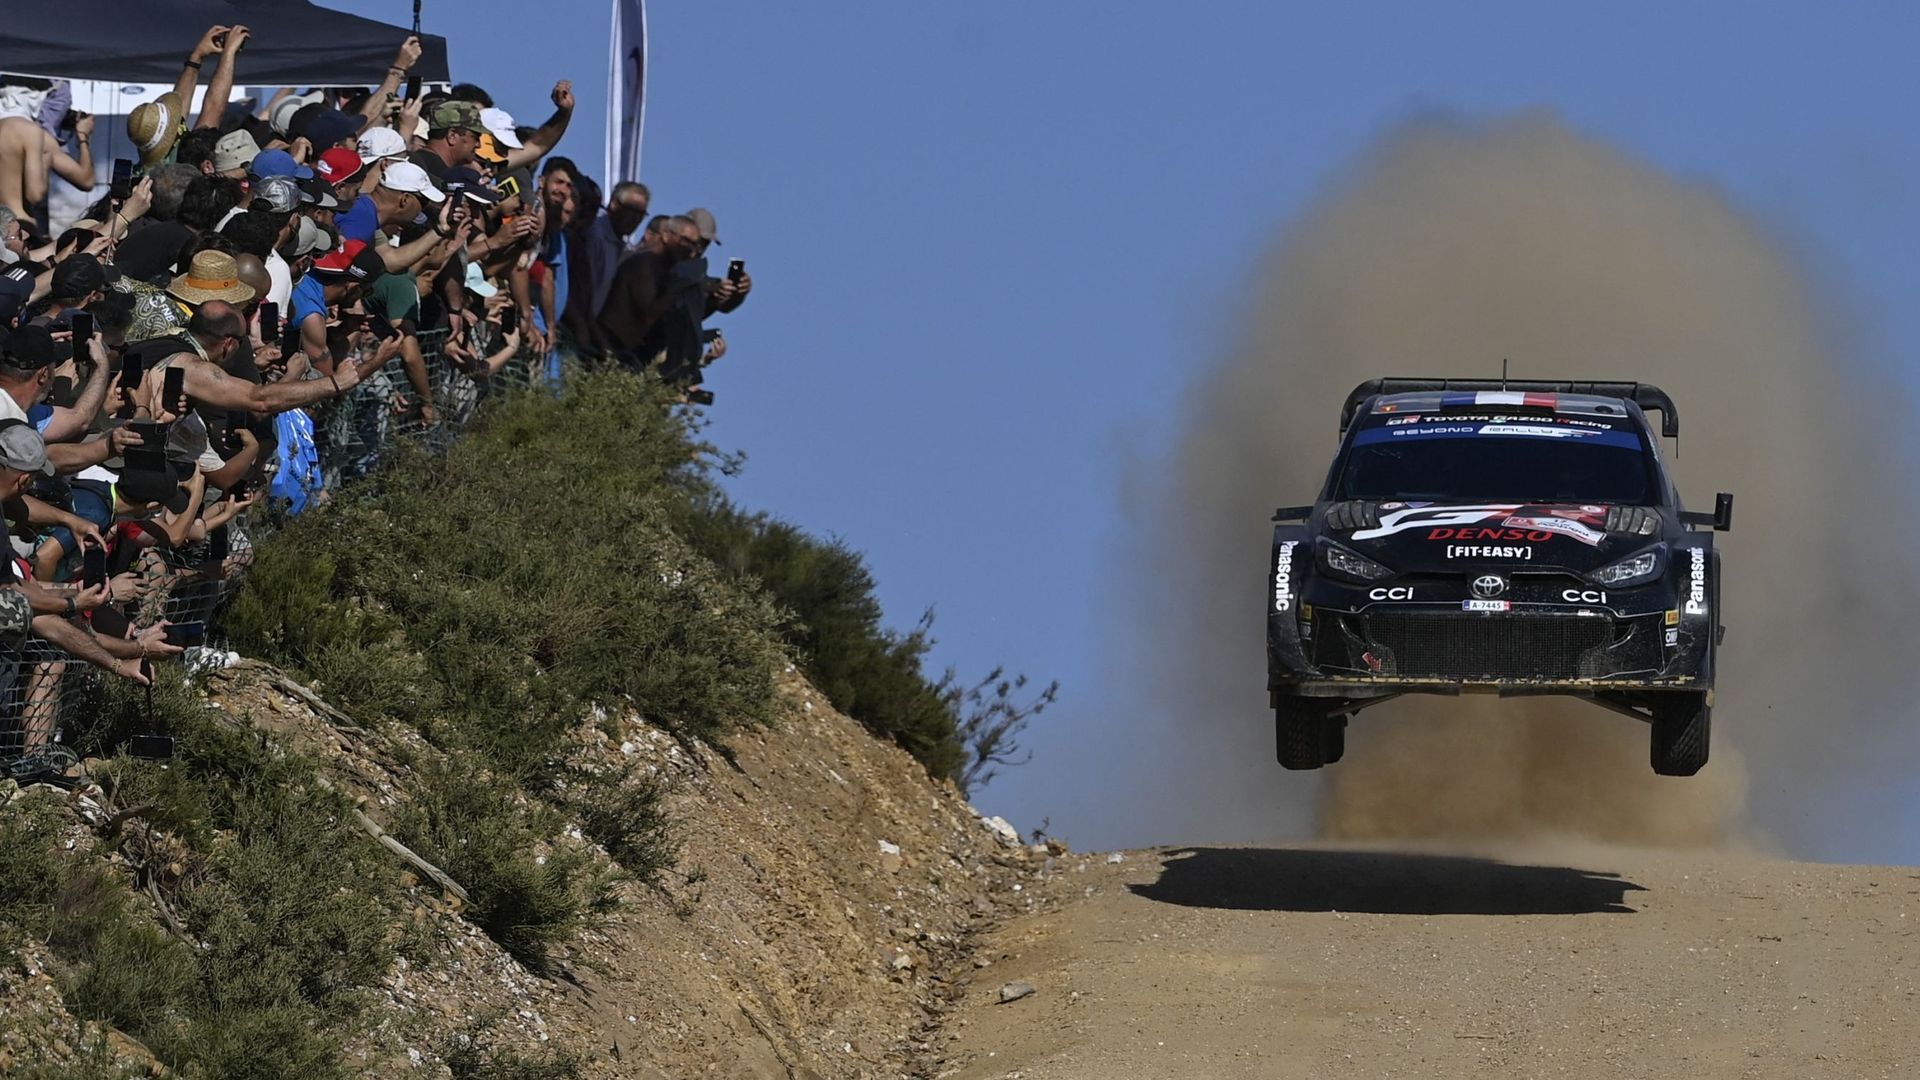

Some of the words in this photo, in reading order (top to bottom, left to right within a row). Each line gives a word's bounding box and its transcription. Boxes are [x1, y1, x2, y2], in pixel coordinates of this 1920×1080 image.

[159, 303, 175, 321] FNB
[1493, 415, 1553, 423] GAZOO
[1557, 418, 1612, 429] Racing
[1393, 427, 1473, 436] BEYOND
[1489, 426, 1552, 434] RALLY
[1428, 528, 1553, 542] DENSO
